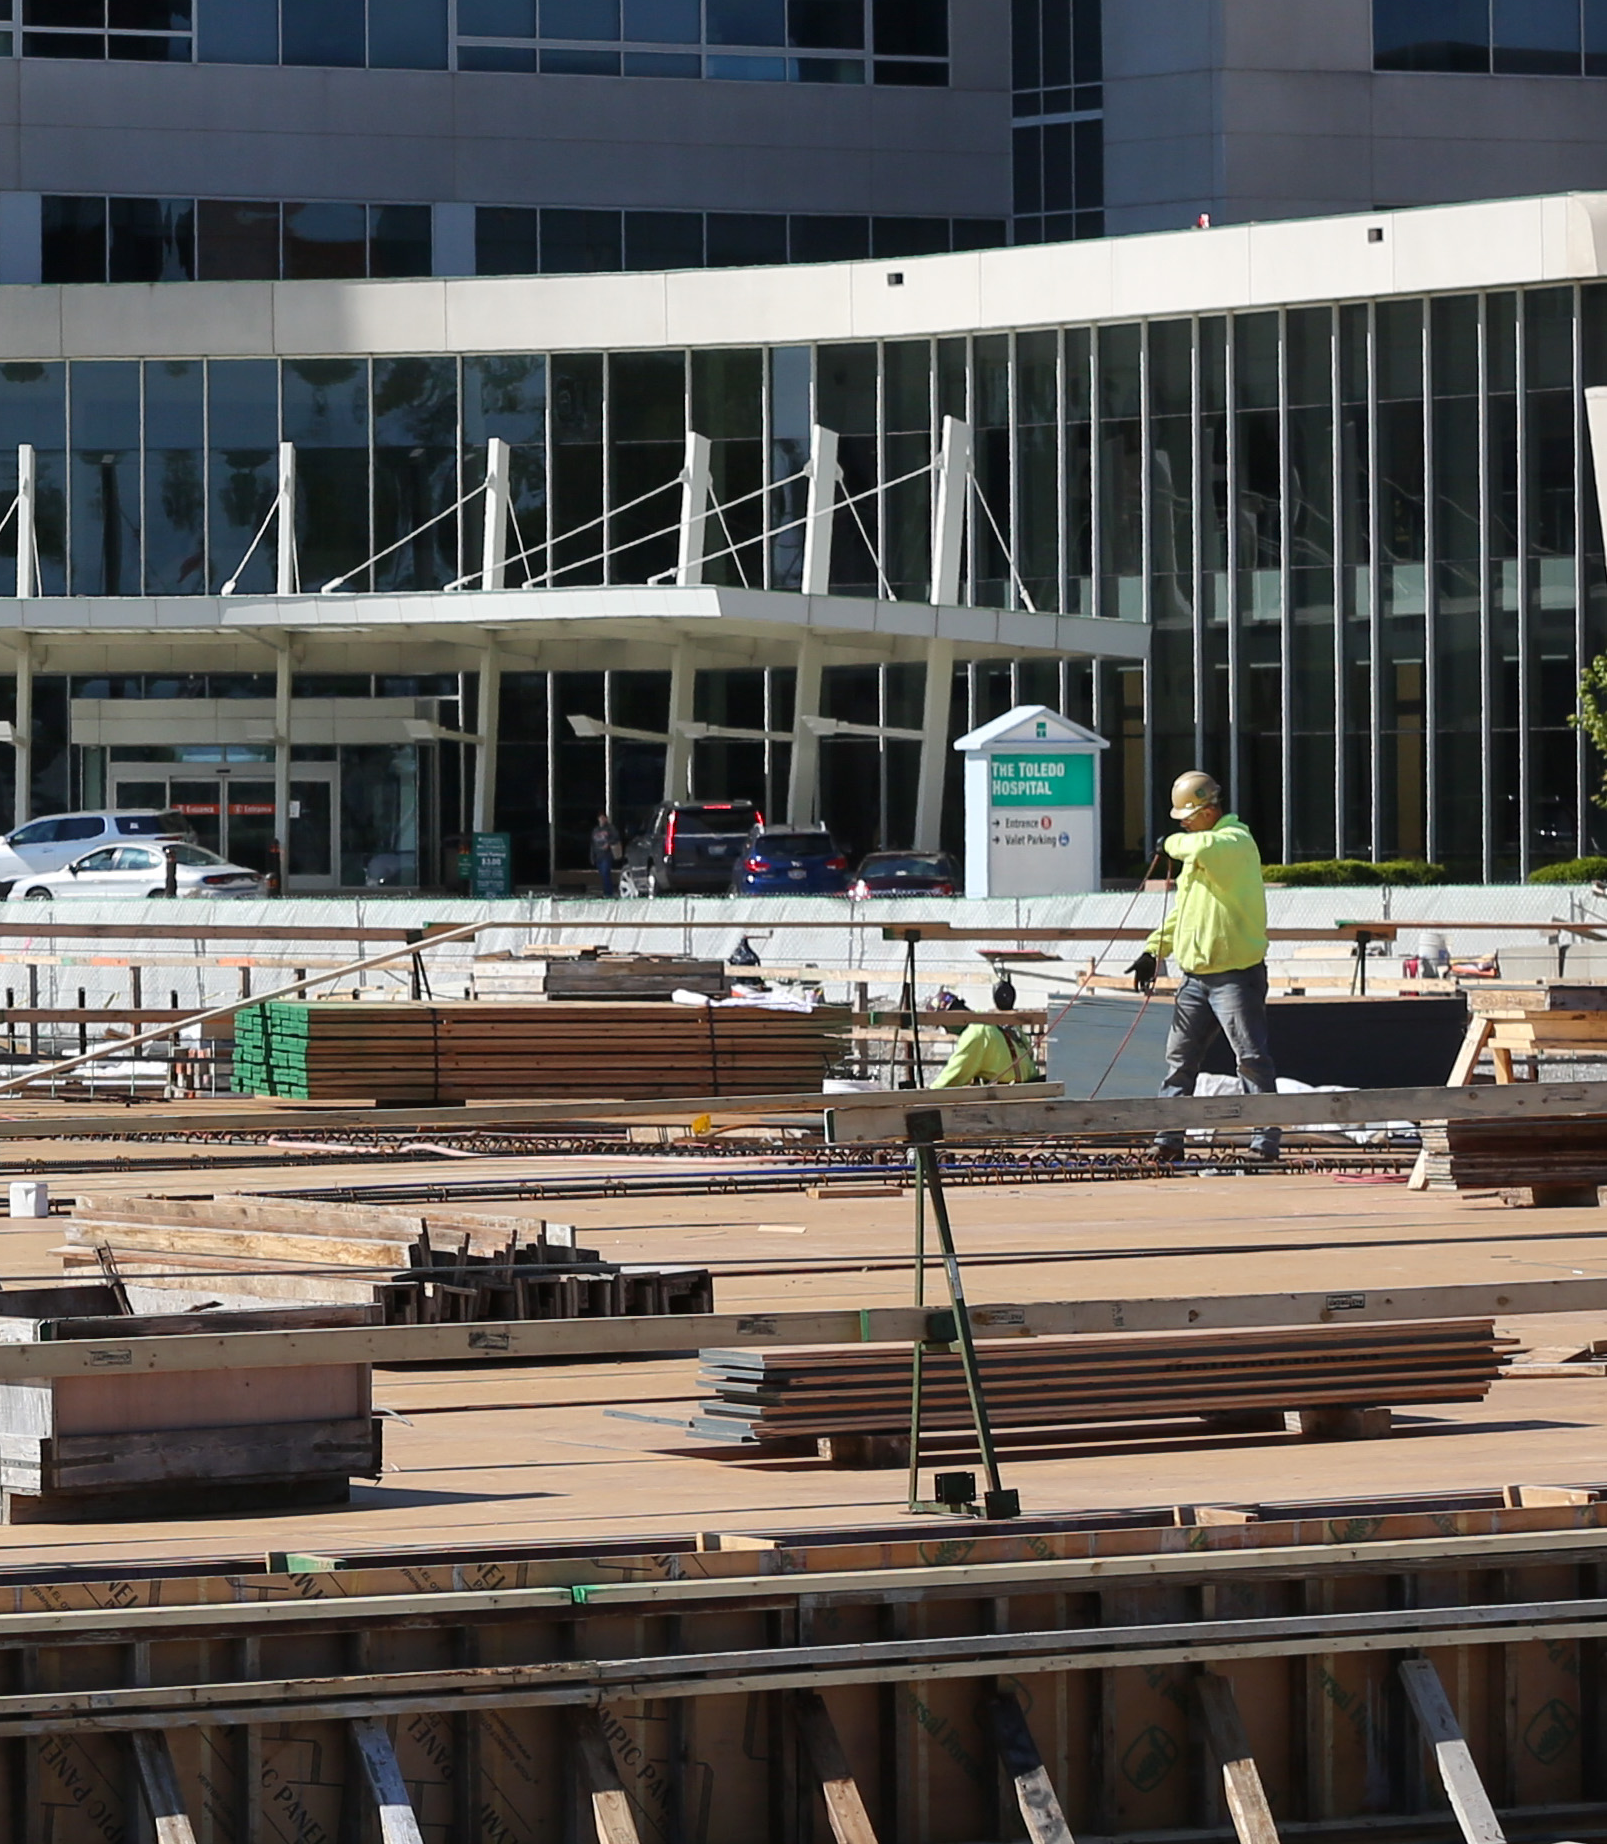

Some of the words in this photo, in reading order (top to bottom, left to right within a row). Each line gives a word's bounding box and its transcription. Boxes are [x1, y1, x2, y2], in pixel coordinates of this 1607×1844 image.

[992, 762, 1015, 778] THE
[1018, 761, 1066, 778] TOLEDO
[992, 780, 1052, 796] HOSPITAL
[1005, 817, 1039, 830] Entrance
[1005, 834, 1025, 846] Valet
[1026, 834, 1057, 848] Parking
[37, 1735, 91, 1802] PANEL
